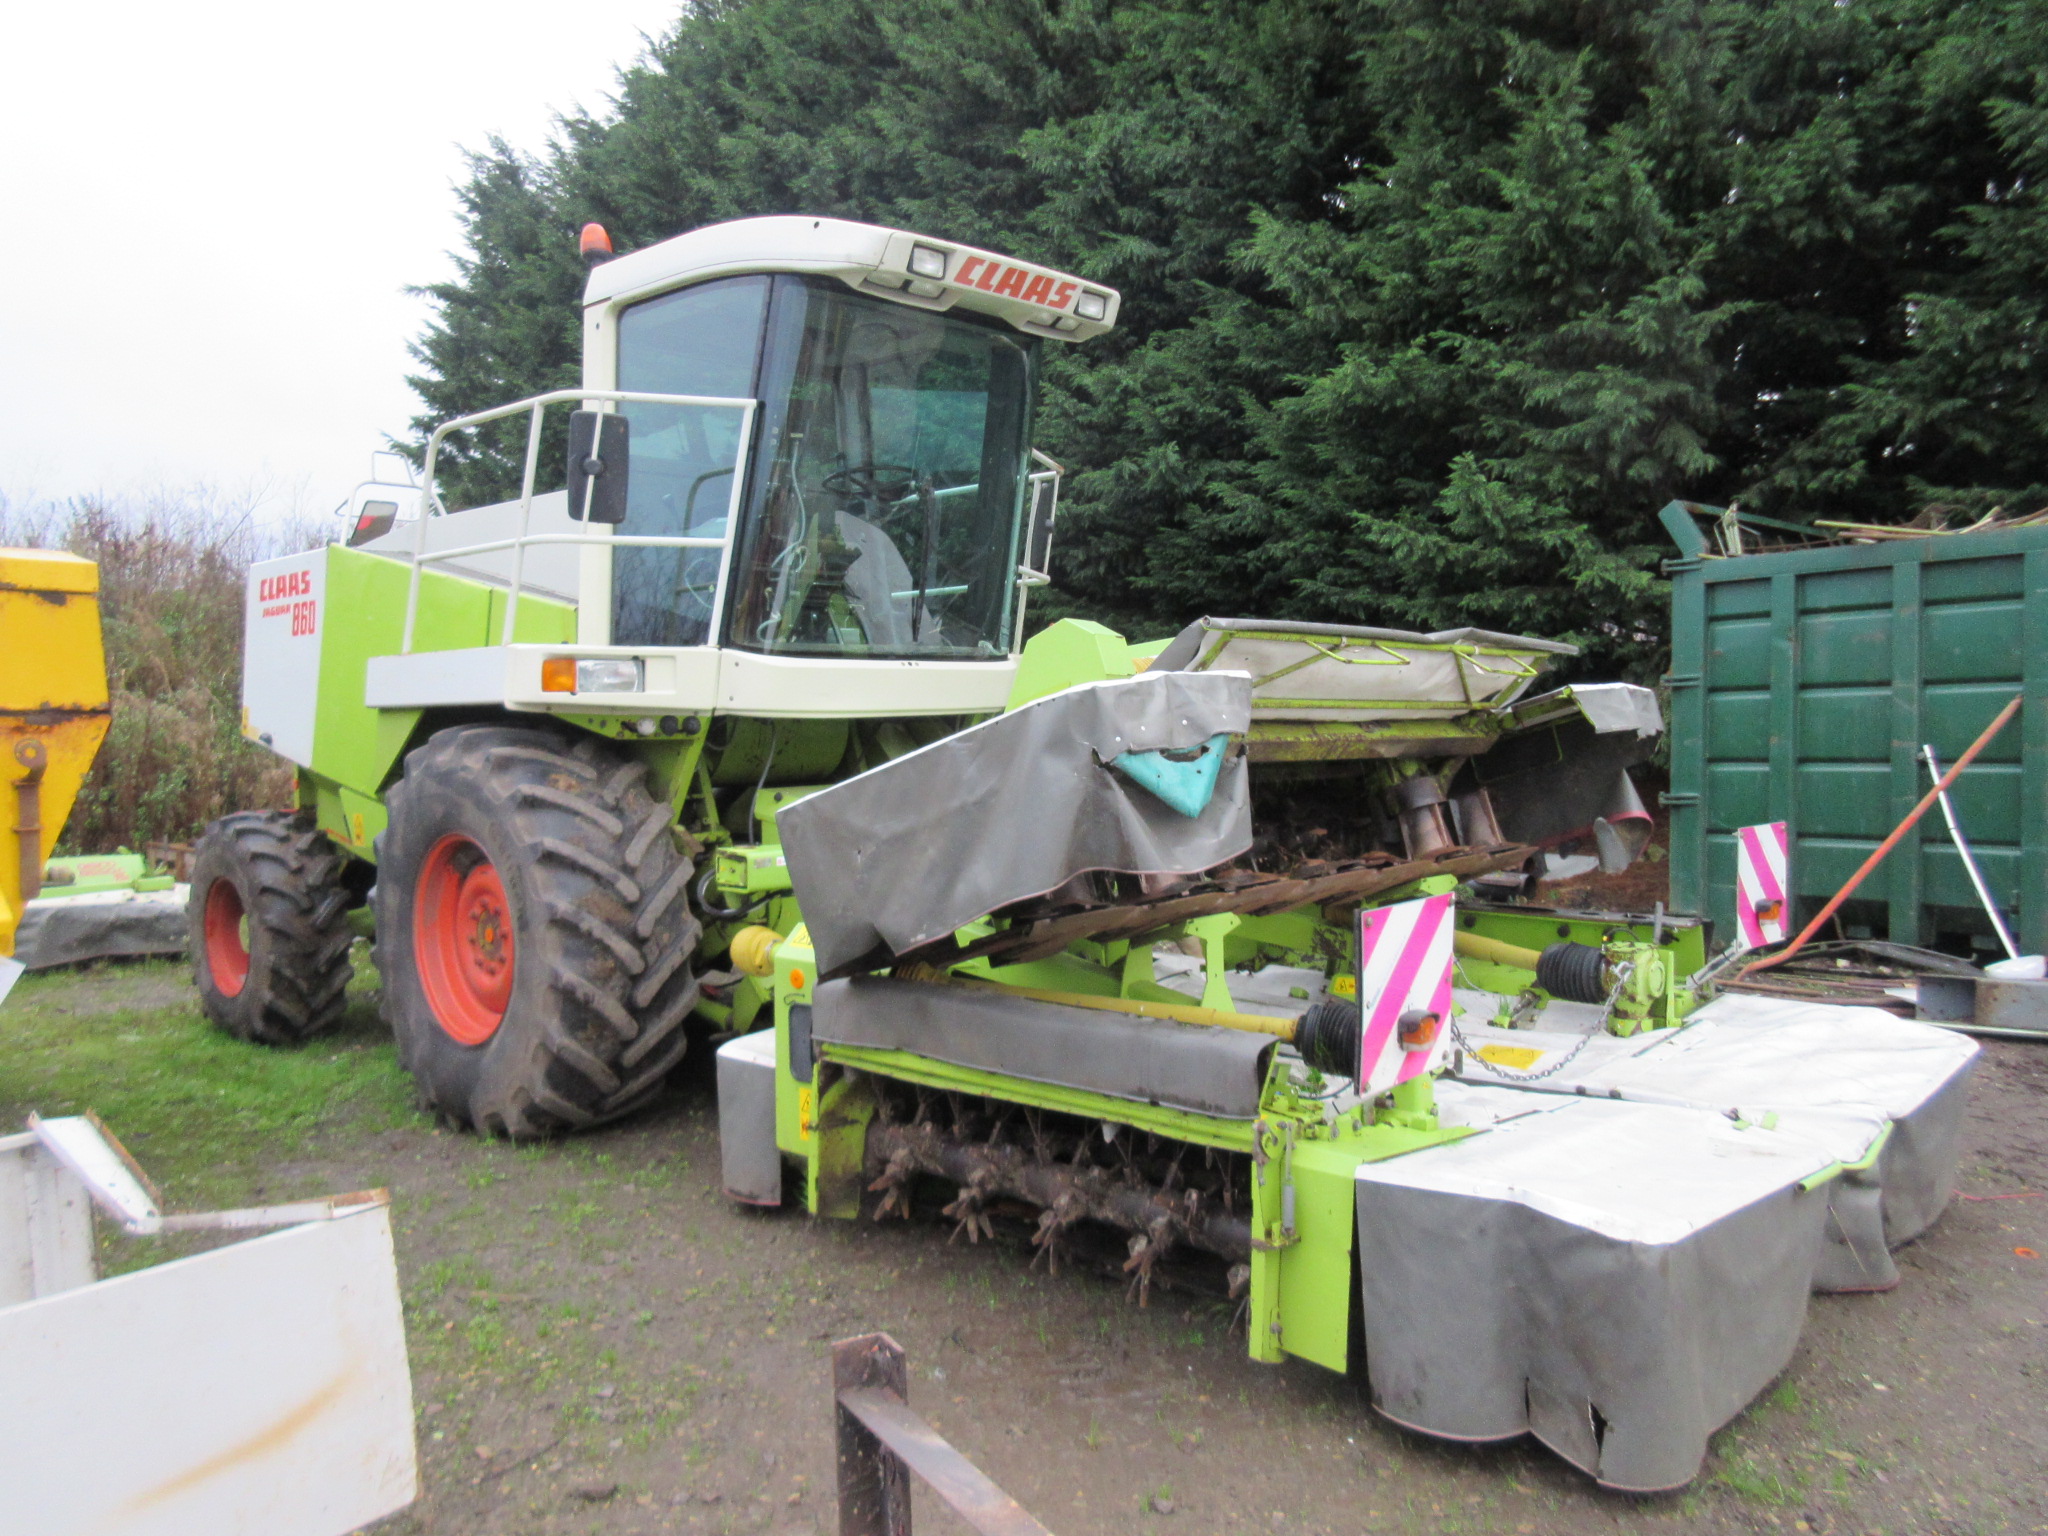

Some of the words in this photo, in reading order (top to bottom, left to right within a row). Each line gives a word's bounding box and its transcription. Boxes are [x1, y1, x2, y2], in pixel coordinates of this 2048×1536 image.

[953, 256, 1079, 310] CLAAS
[260, 570, 311, 602] CLAAS
[292, 600, 316, 636] 860
